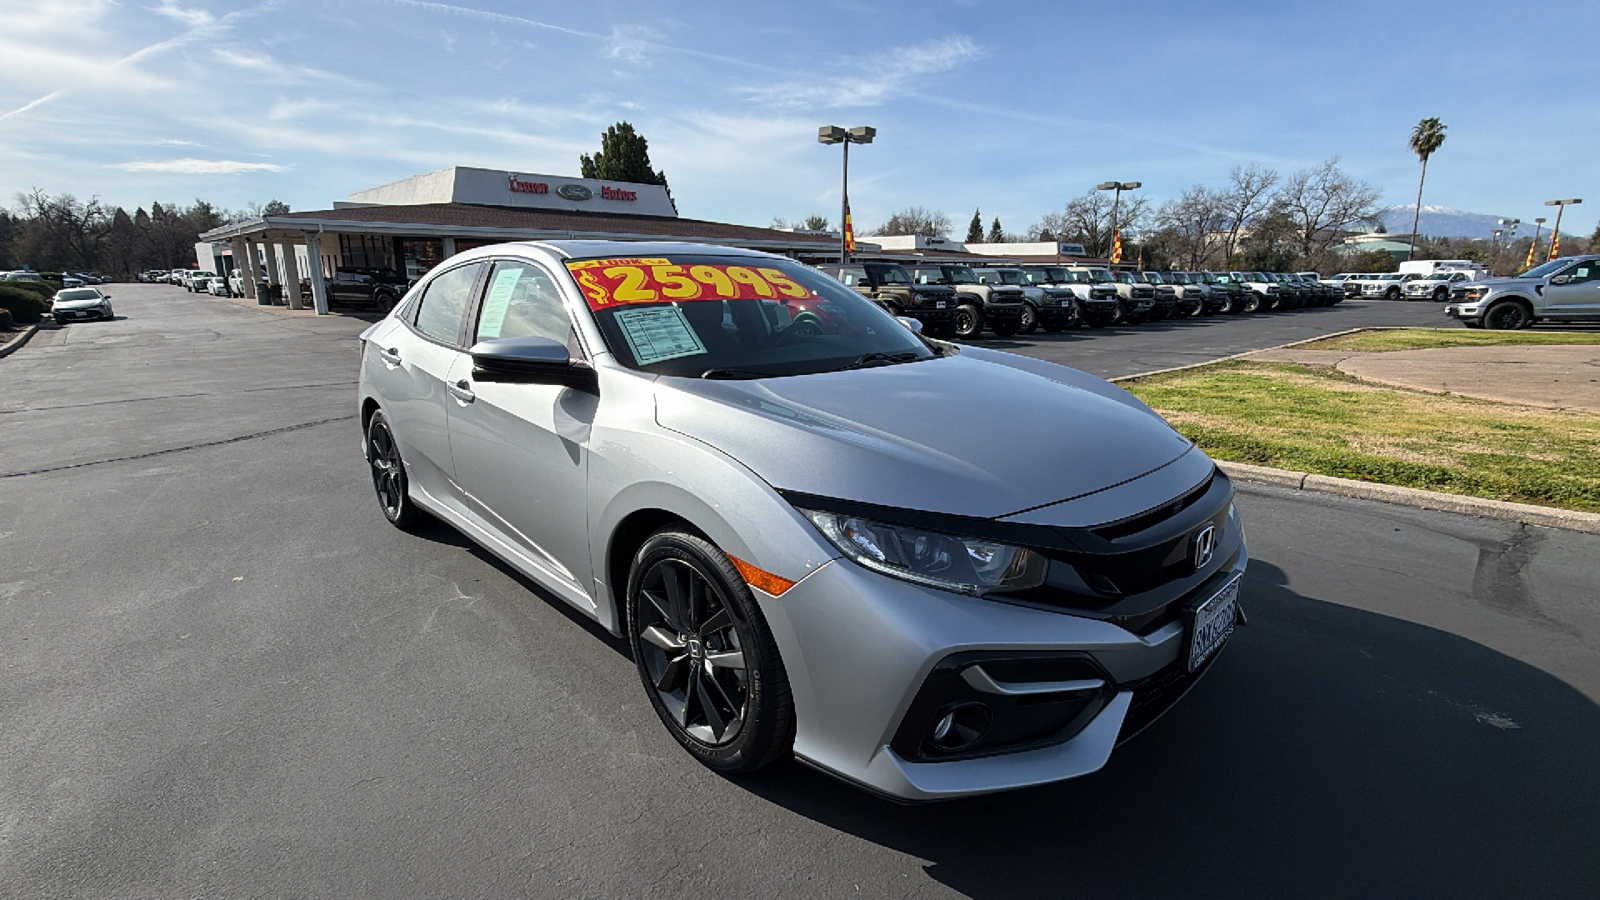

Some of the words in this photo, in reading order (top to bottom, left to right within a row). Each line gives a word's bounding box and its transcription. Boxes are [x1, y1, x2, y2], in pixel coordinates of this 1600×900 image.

[509, 178, 549, 195] Crown
[601, 186, 638, 201] Motors
[597, 258, 641, 267] LOOK
[578, 265, 811, 305] $25995
